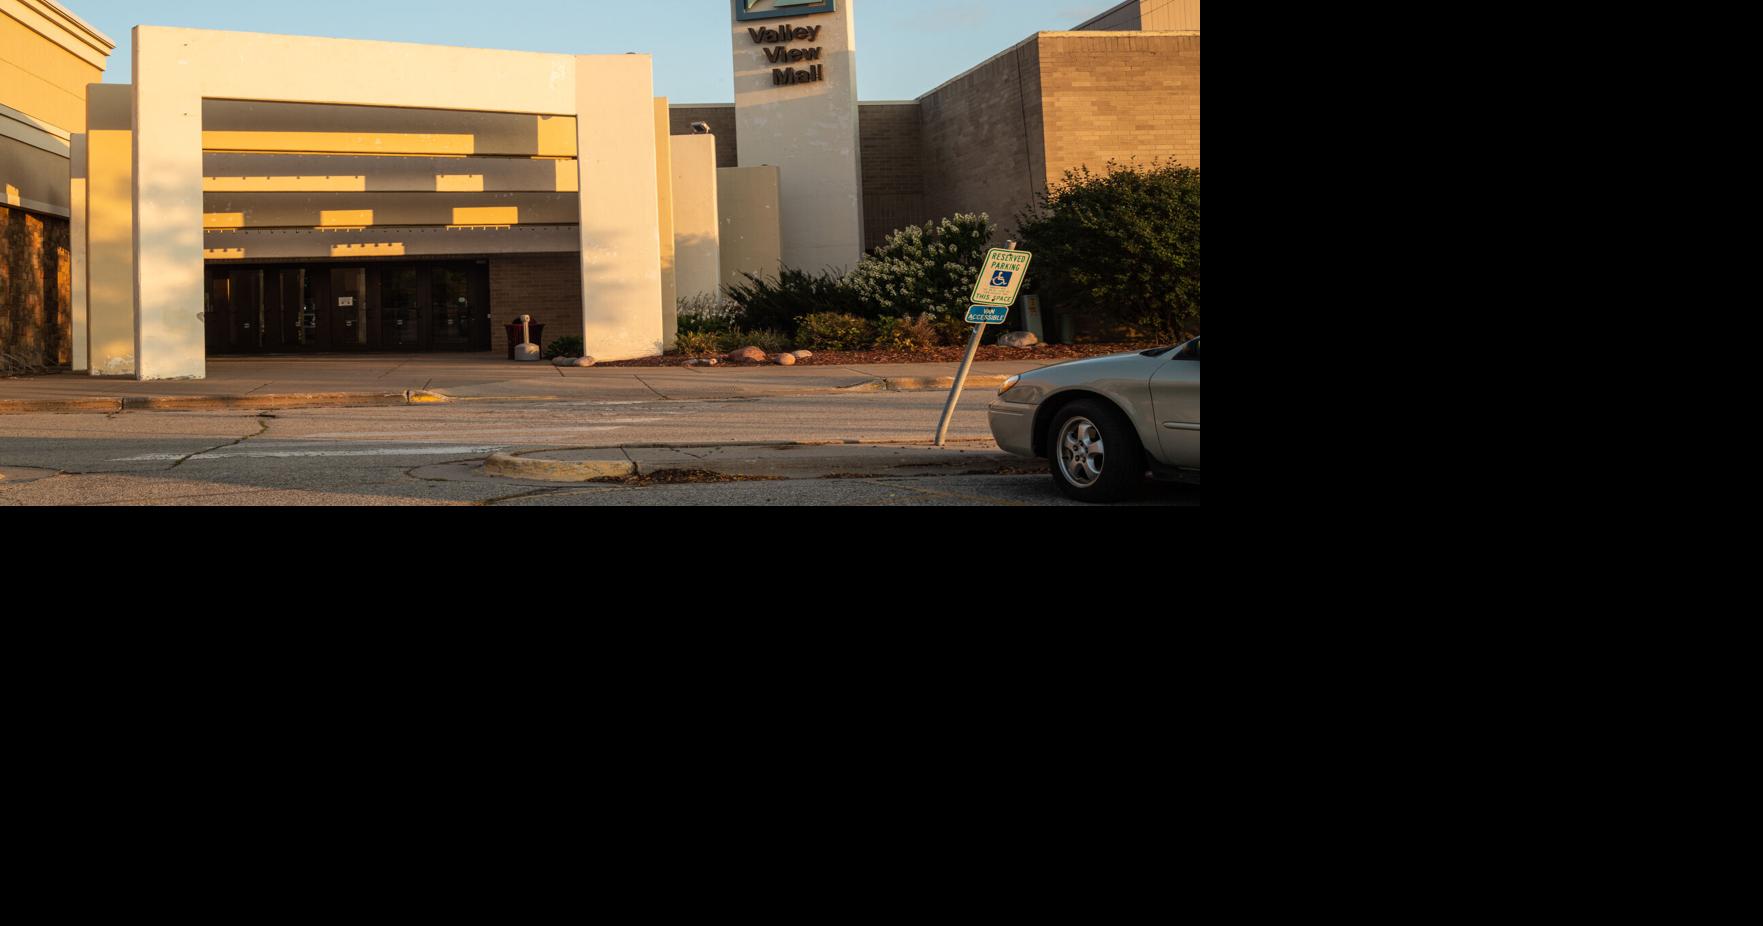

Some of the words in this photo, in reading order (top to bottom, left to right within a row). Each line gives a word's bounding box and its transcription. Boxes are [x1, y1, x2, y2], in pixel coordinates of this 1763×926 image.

[747, 24, 822, 43] Valley
[763, 46, 822, 63] View
[772, 64, 824, 85] Mall
[991, 262, 1020, 271] PARKING
[992, 253, 1026, 263] RESERVED
